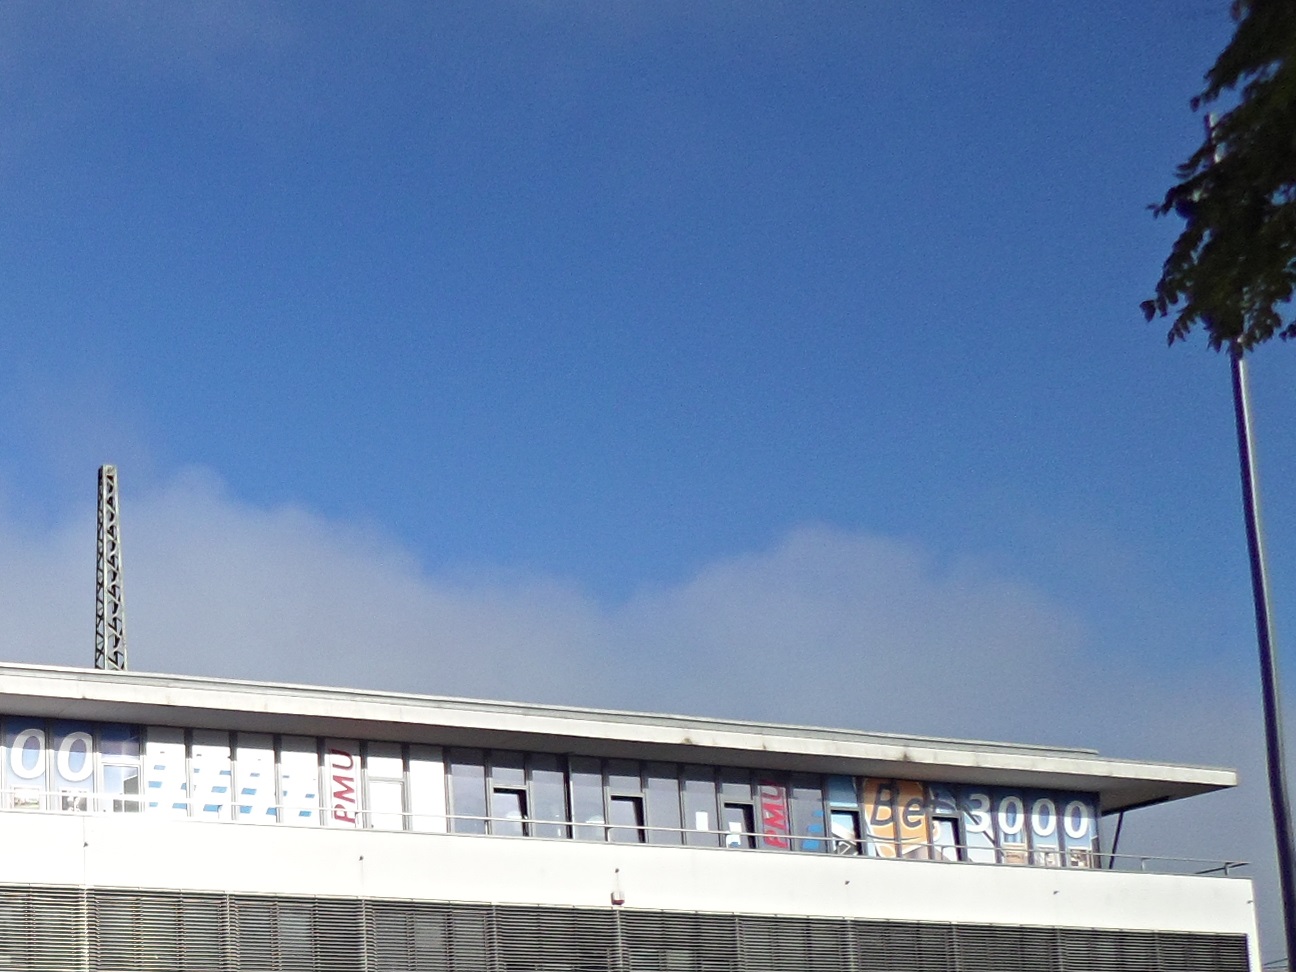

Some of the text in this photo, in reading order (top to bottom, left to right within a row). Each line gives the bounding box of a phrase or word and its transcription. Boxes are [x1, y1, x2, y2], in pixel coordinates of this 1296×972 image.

[330, 748, 357, 824] PMU
[762, 779, 789, 850] PMU
[965, 793, 1089, 839] 3000
